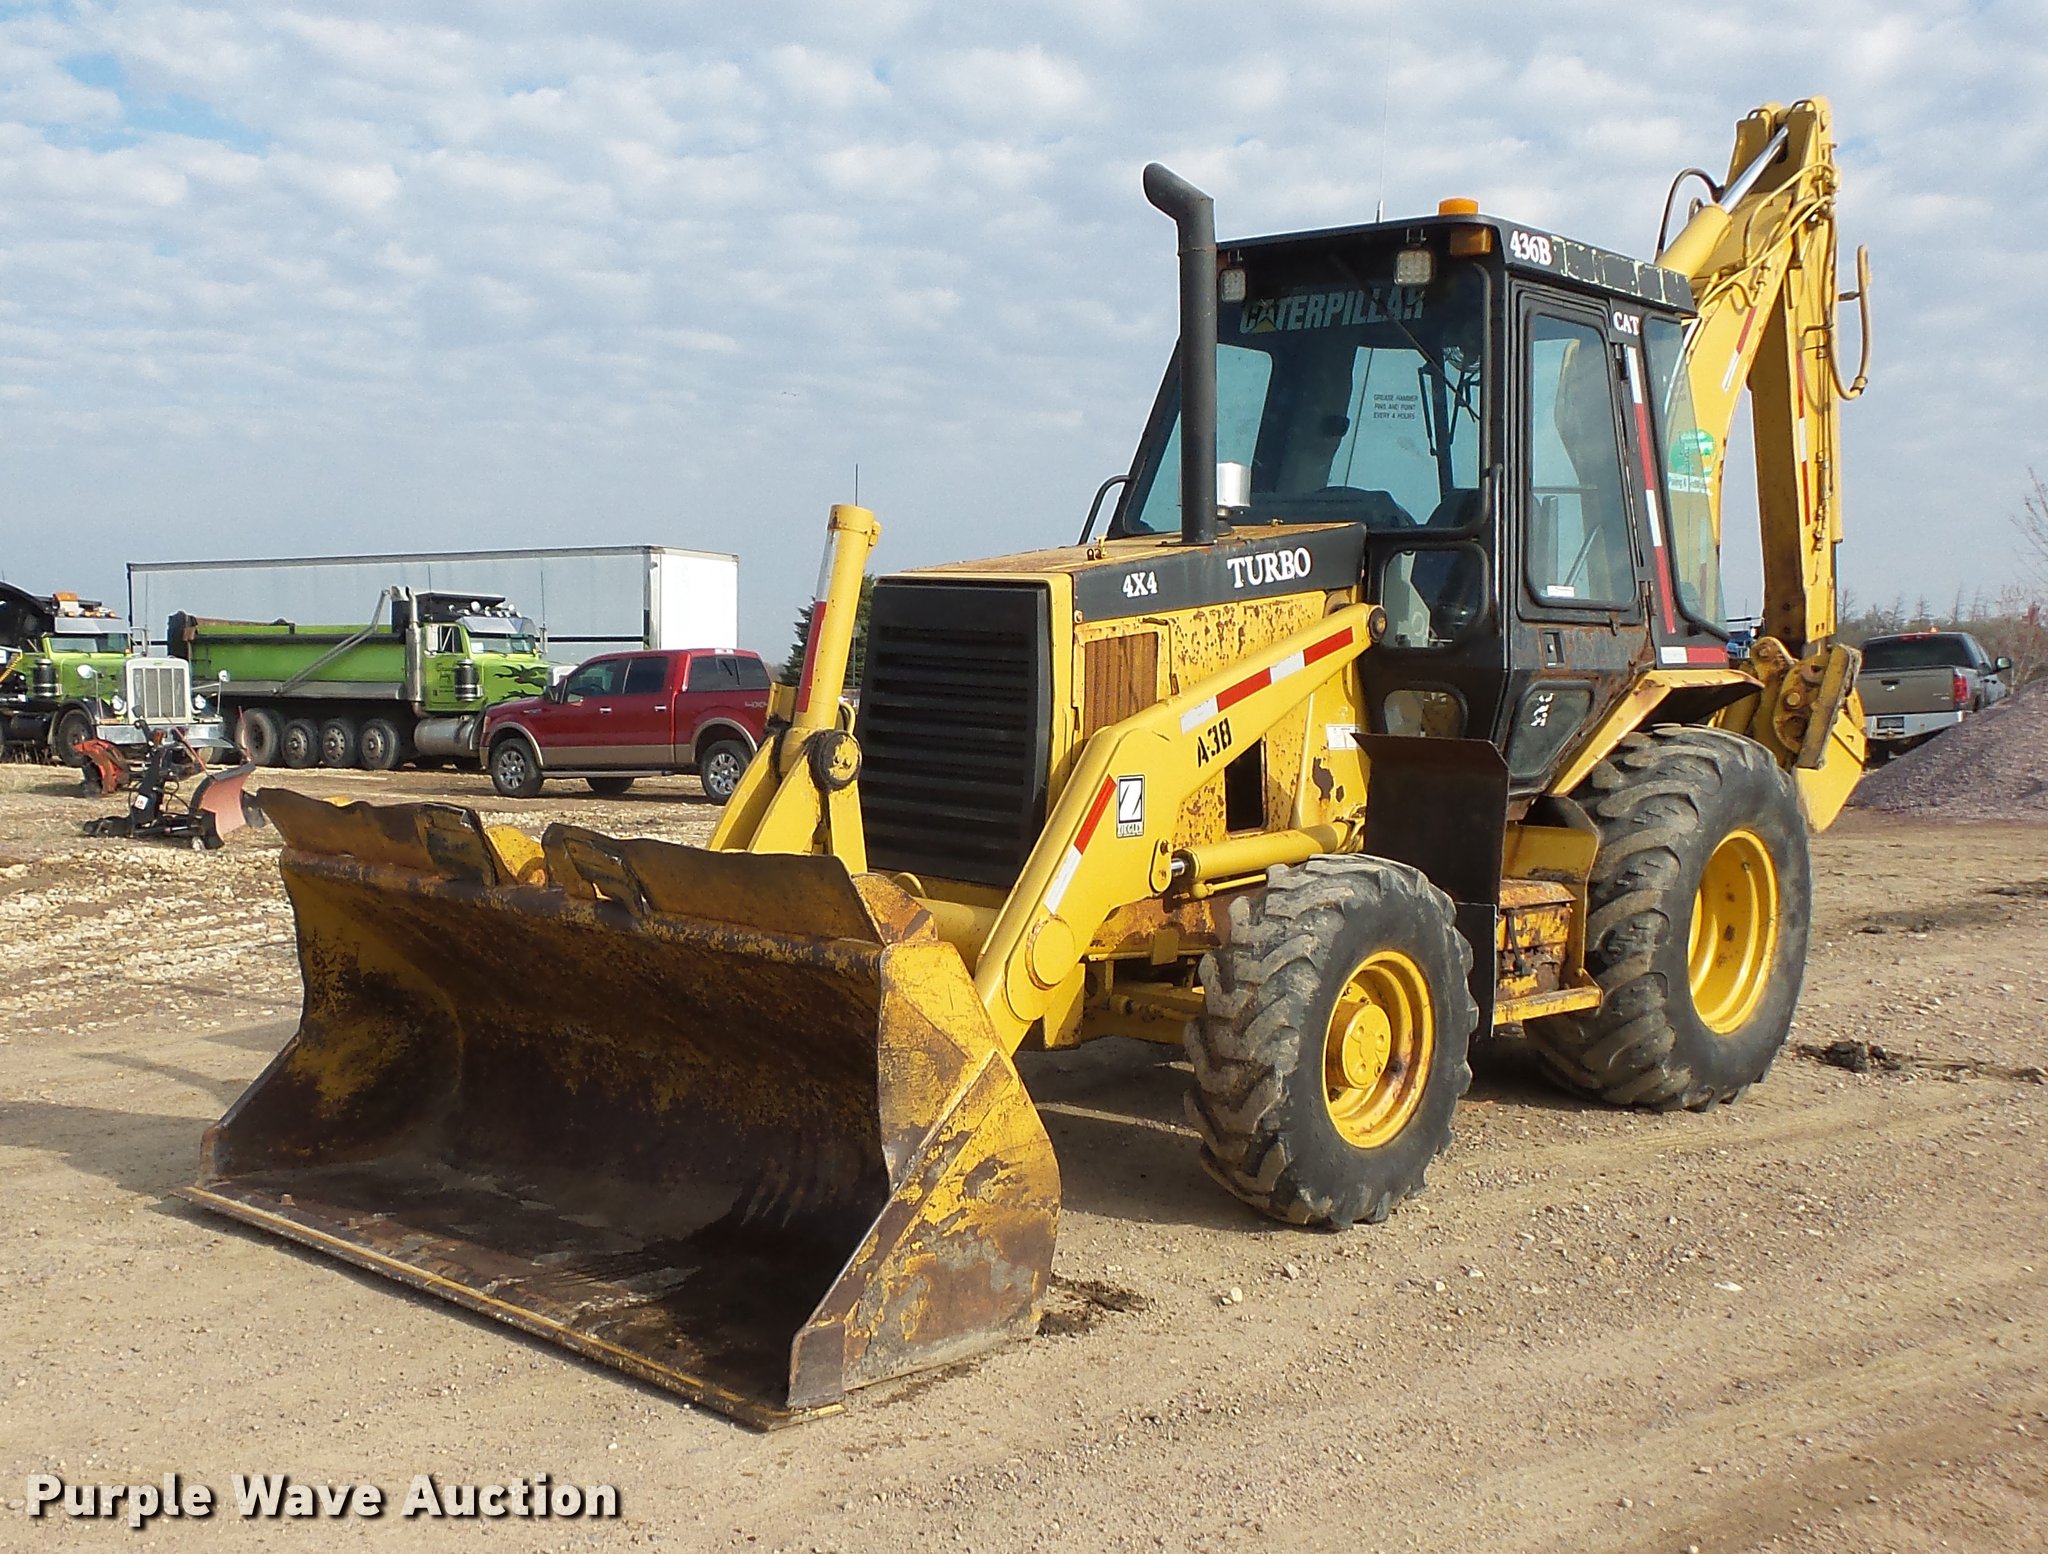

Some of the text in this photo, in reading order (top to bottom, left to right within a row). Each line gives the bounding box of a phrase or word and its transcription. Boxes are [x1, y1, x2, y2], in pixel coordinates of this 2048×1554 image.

[1510, 230, 1553, 266] 436B
[1239, 285, 1425, 334] CATERPILLAR
[1613, 311, 1641, 336] CAT
[1122, 571, 1158, 598] 4X4
[1226, 547, 1312, 589] TURBO
